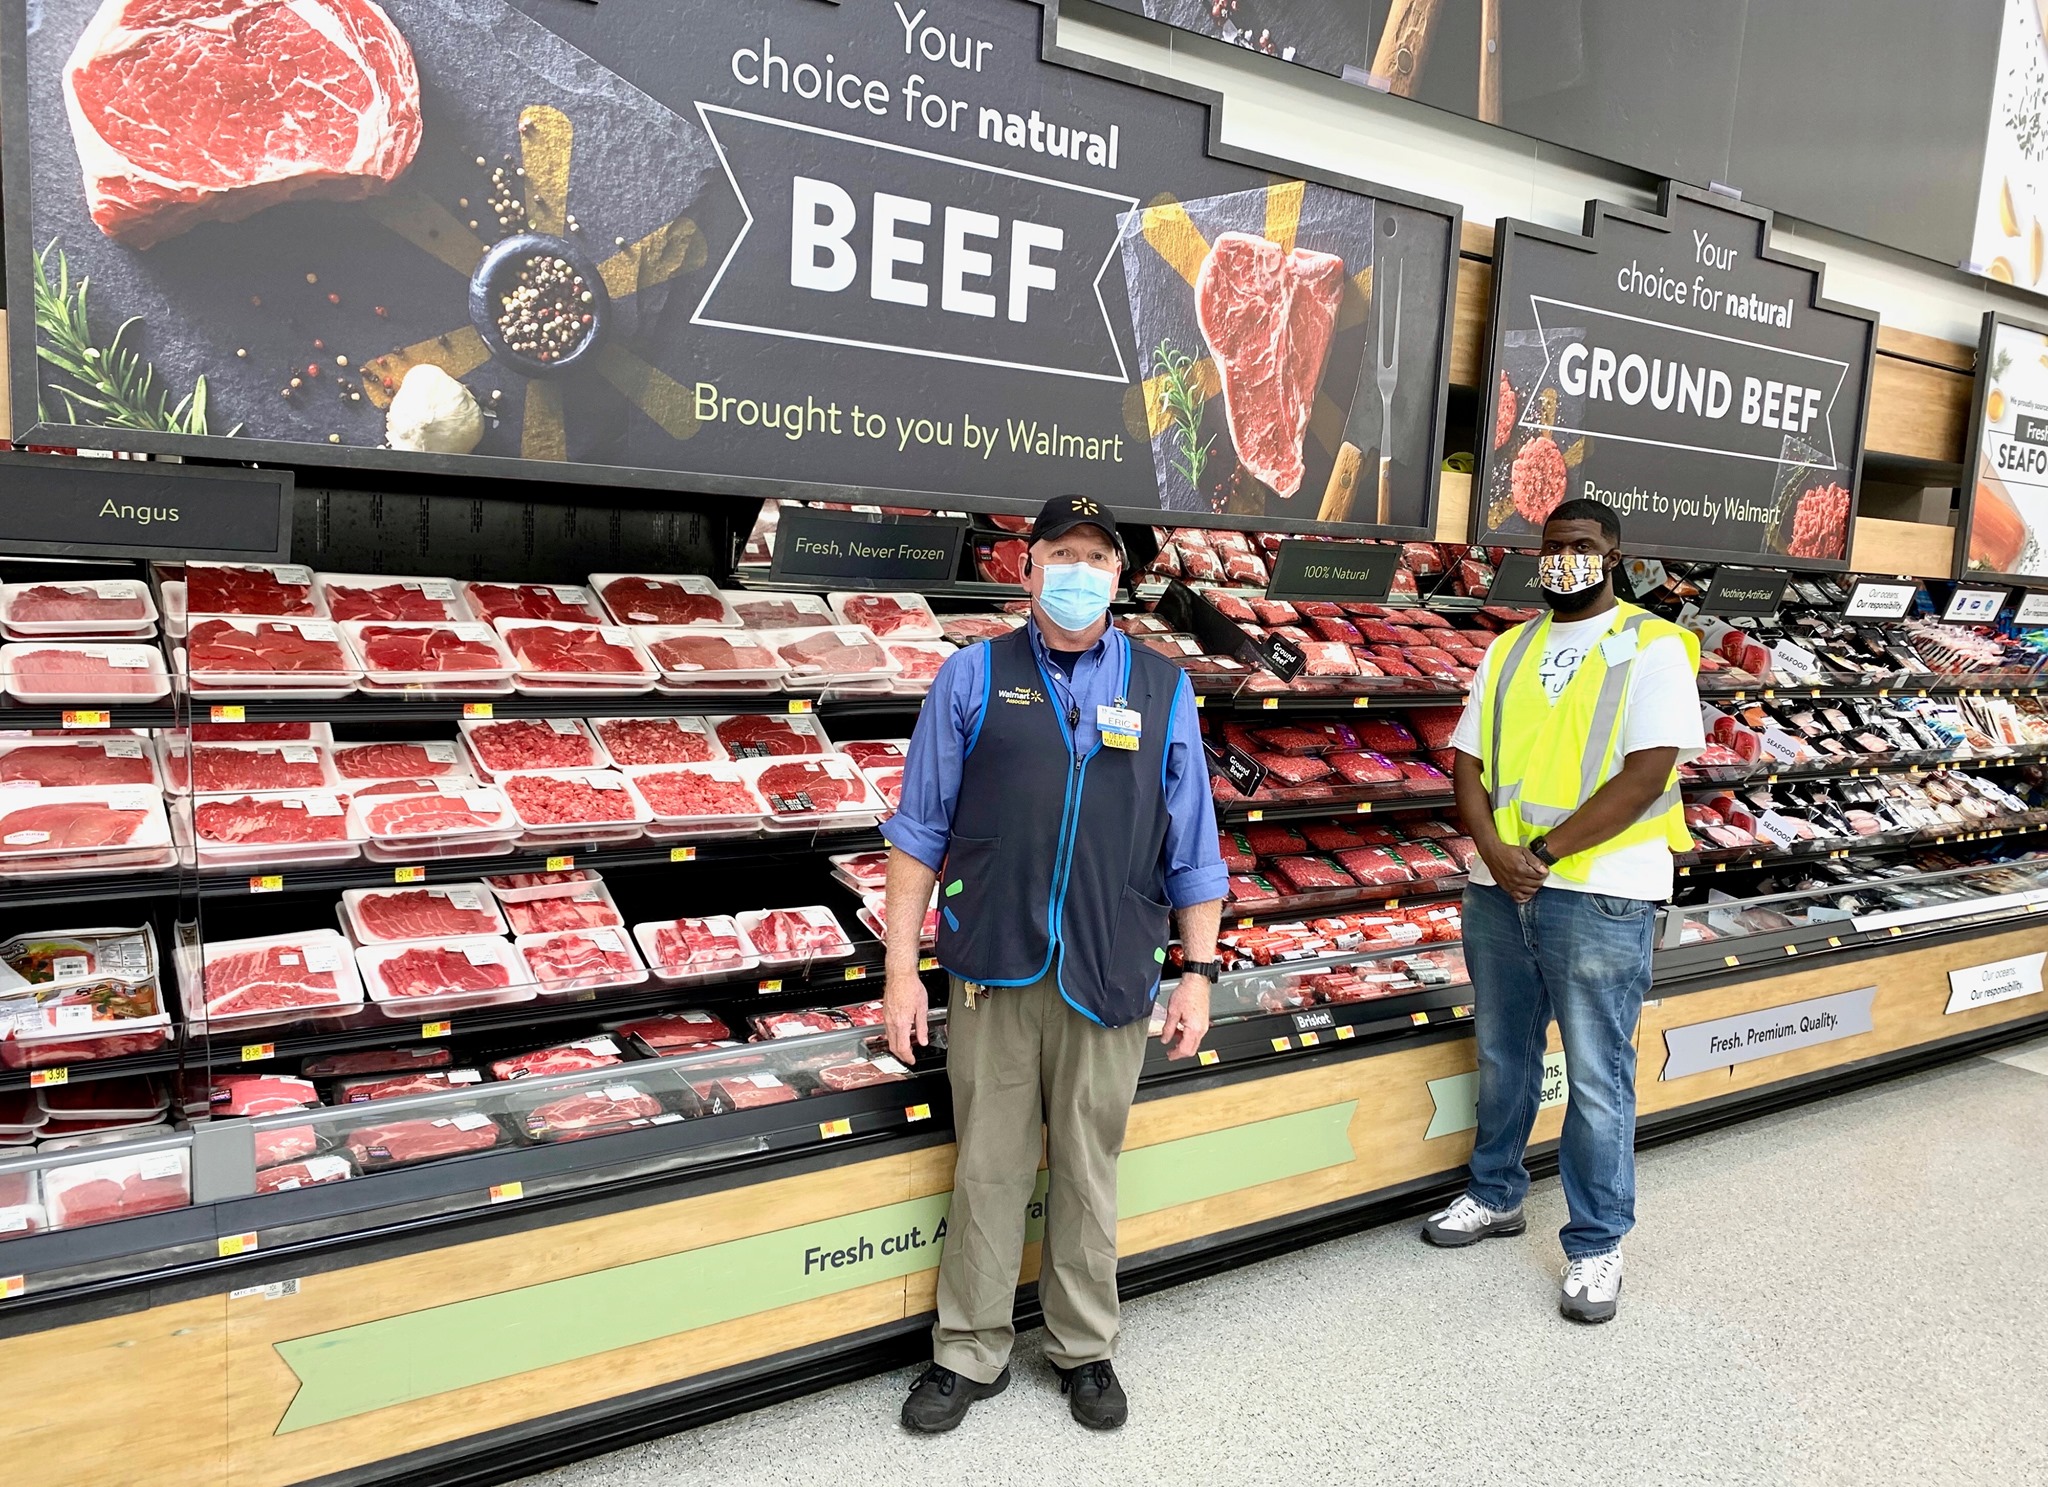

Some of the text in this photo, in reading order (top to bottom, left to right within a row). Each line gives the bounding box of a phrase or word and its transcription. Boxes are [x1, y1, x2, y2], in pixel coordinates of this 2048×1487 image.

[894, 1, 994, 73] Your
[731, 38, 1118, 170] choice for natural
[790, 176, 1064, 323] BEEF
[1693, 229, 1738, 272] Your
[1617, 260, 1794, 328] choice for natural
[1558, 342, 1822, 435] GROUND BEEF
[694, 382, 1124, 463] Brought to you by Walmart
[99, 499, 180, 525] Angus
[1583, 481, 1781, 525] Brought to you by Walmart
[795, 537, 945, 561] Fresh, Never Frozen
[1303, 565, 1370, 581] 100% Natural
[1720, 588, 1774, 601] Nothing Artificial
[1857, 599, 1868, 609] Our
[1271, 651, 1289, 666] Beef
[1273, 642, 1297, 663] Ground
[1777, 650, 1808, 672] SEAFOOD
[998, 689, 1030, 700] Walmart
[1108, 717, 1131, 728] ERIC
[1104, 737, 1138, 749] MANAGER
[1766, 737, 1796, 758] SEAFOOD
[1229, 755, 1250, 776] Ground
[1229, 765, 1244, 780] Beef
[1762, 820, 1792, 844] SEAFOOD
[1971, 989, 1983, 1001] Our
[1297, 1012, 1331, 1028] Brisket
[1710, 1012, 1838, 1053] Fresh. Premium. Quality.
[1545, 1064, 1563, 1079] ns.
[1540, 1080, 1562, 1102] eef.
[804, 1236, 874, 1276] Fresh
[880, 1226, 927, 1256] cut.
